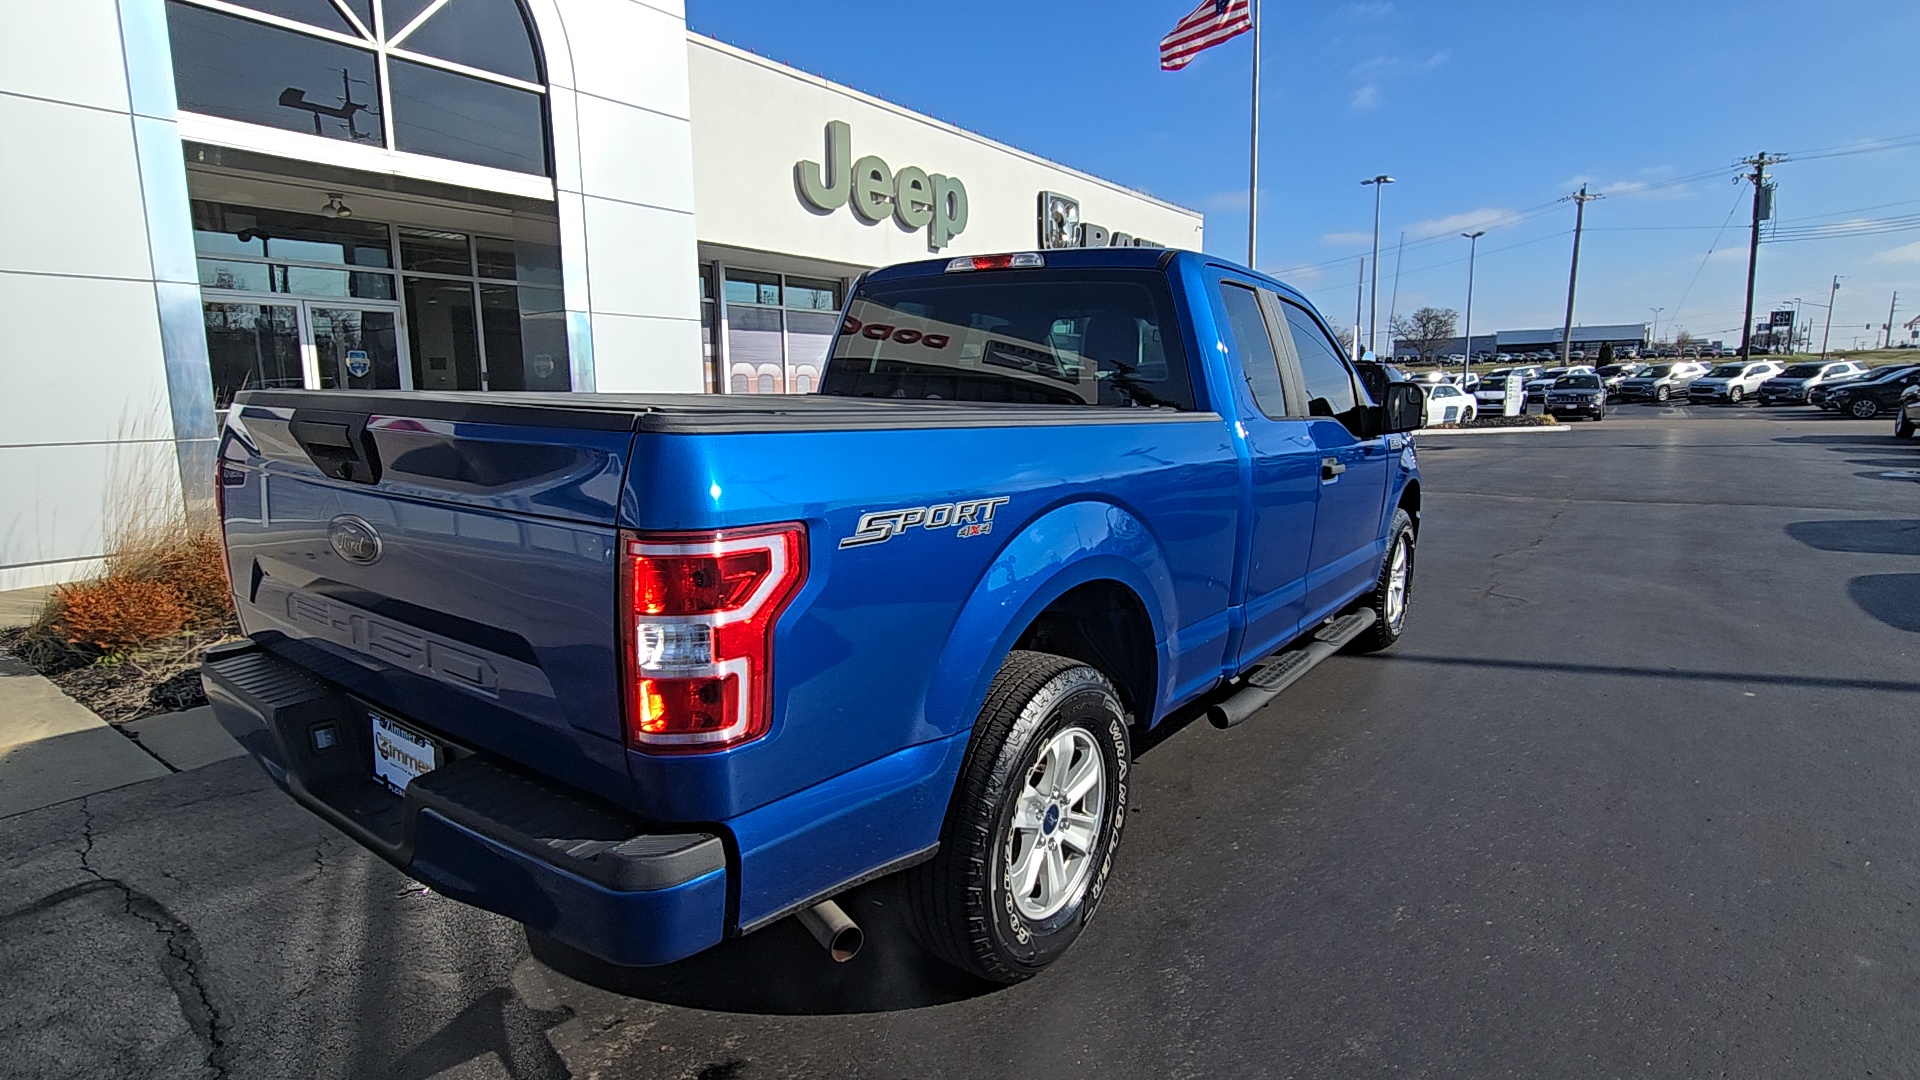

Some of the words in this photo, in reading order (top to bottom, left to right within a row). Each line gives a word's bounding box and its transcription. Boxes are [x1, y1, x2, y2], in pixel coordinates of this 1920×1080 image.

[792, 119, 969, 253] Jeep
[1081, 222, 1166, 248] RA
[838, 496, 1011, 550] SPORT
[285, 591, 500, 700] F-150
[1092, 719, 1127, 899] WRANGLER
